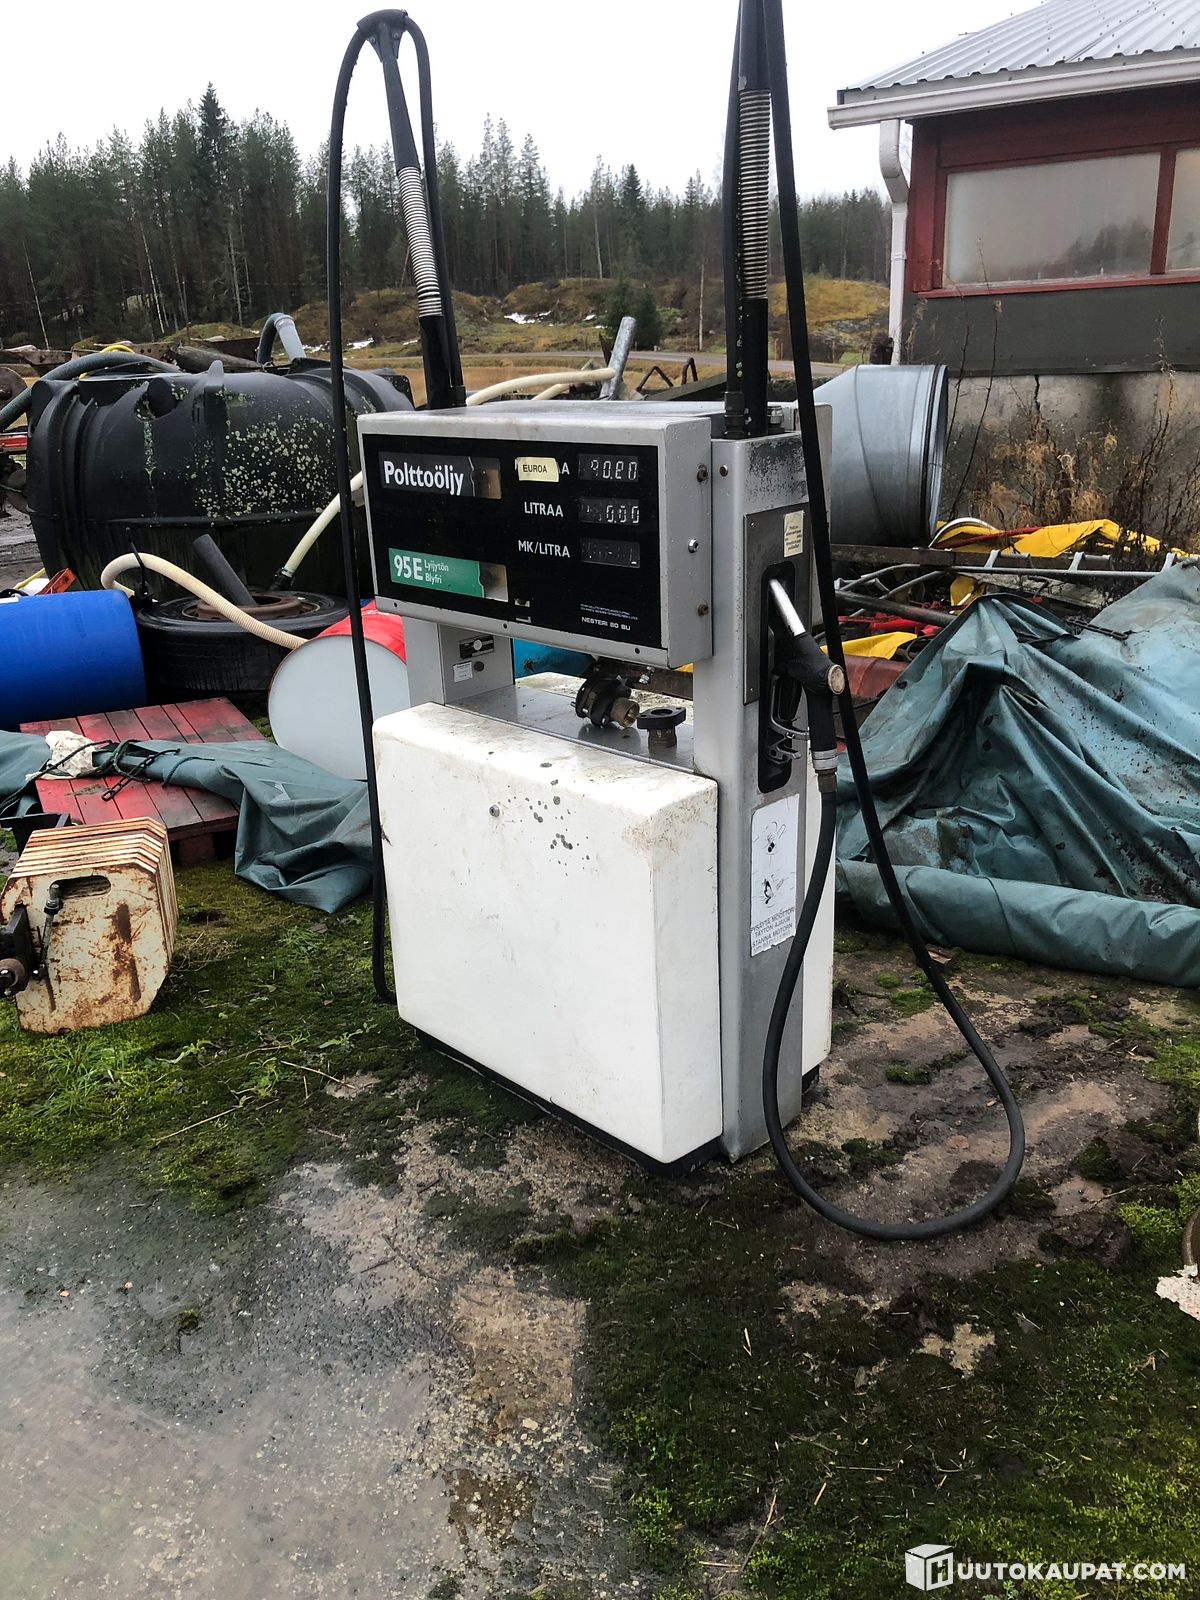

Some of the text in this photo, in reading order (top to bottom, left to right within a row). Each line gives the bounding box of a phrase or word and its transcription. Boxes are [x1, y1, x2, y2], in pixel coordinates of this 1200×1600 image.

[522, 464, 548, 473] EUROA
[383, 460, 464, 496] Polttoöljy
[524, 501, 564, 517] LITRAA
[518, 540, 571, 558] MK/LITRA
[424, 559, 449, 572] Lyijytön
[425, 572, 442, 585] Blyfri
